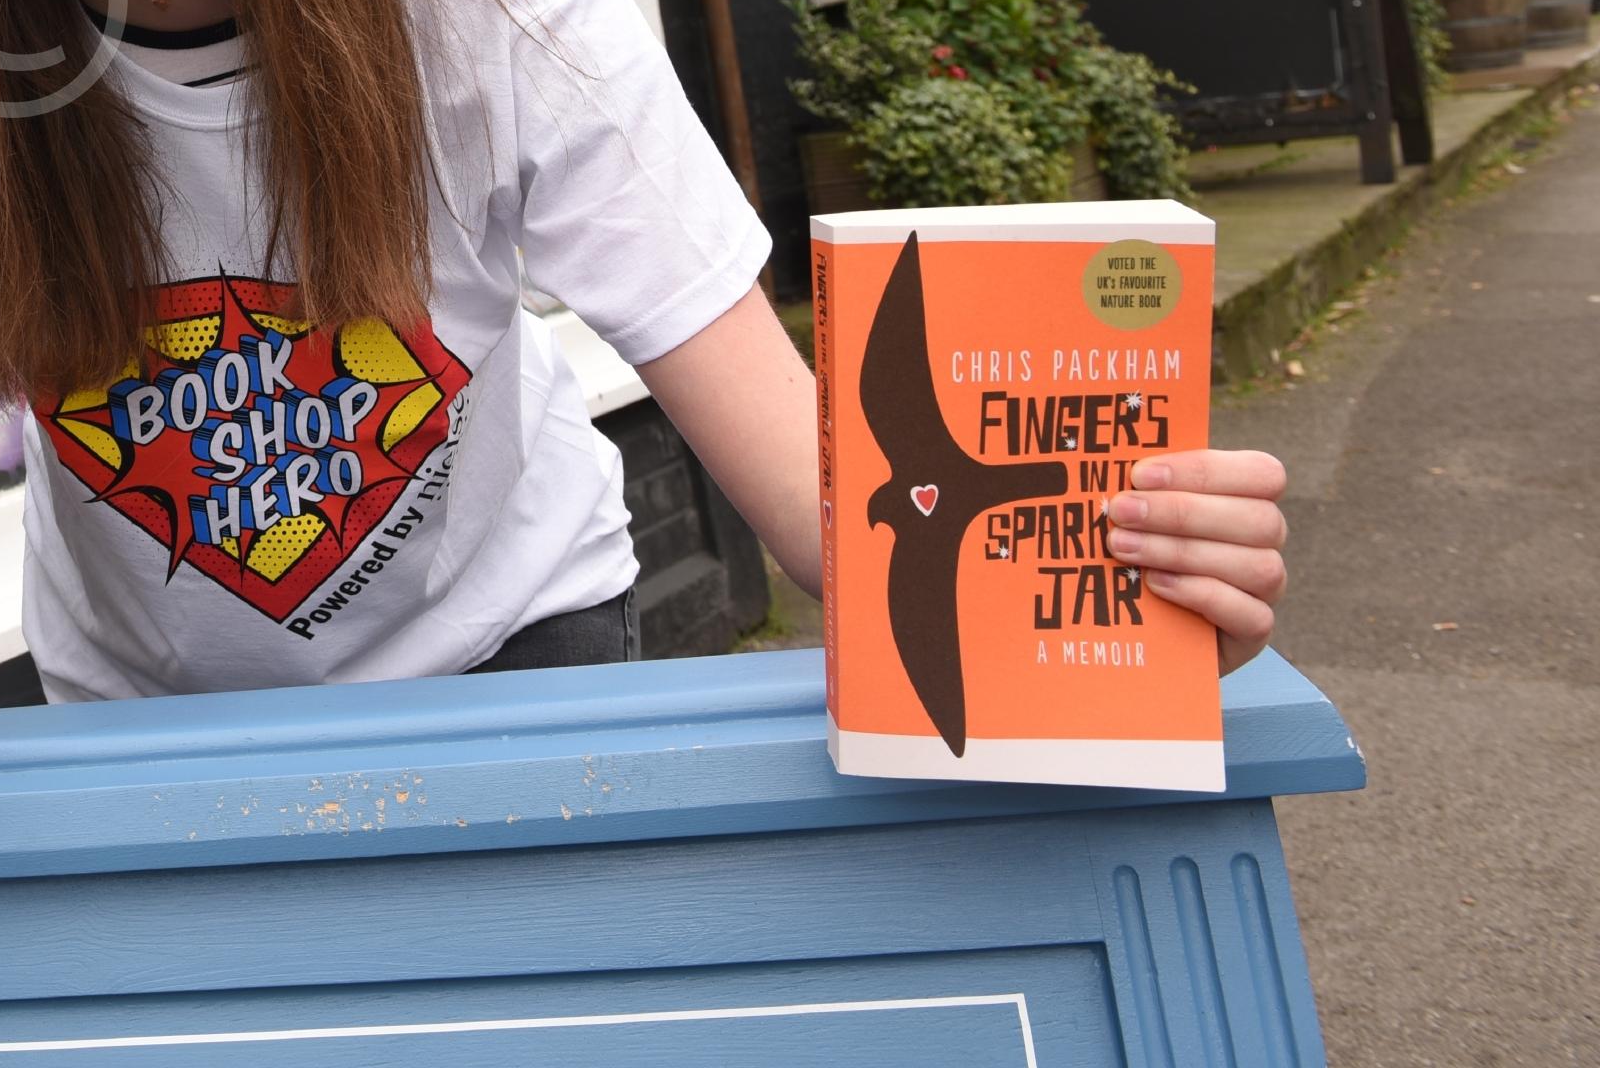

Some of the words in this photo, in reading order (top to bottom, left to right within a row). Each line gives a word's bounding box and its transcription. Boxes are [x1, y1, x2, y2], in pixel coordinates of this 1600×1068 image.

[815, 252, 828, 327] FINGERS
[1096, 276, 1116, 289] UK's
[1119, 276, 1168, 289] FAVOURITE
[1107, 257, 1136, 270] VOTED
[1140, 257, 1157, 270] THE
[1100, 295, 1135, 308] NATURE
[1139, 295, 1162, 308] BOOK
[112, 330, 296, 446] BOOK
[951, 350, 1033, 384] CHRIS
[1052, 348, 1182, 381] PACKHAM
[198, 376, 379, 481] SHOP
[819, 370, 831, 443] SPARKLE
[979, 390, 1170, 456] FINGERS
[196, 445, 363, 546] HERO
[822, 445, 832, 492] JAR
[1079, 460, 1109, 492] IN
[825, 539, 833, 583] CHRIS
[984, 498, 1114, 563] SPARK
[286, 537, 398, 642] Powered
[382, 503, 425, 542] by
[1033, 564, 1144, 630] JAR
[827, 591, 835, 660] PACKHAM
[1037, 641, 1048, 664] A
[1062, 640, 1146, 667] MEMOIR
